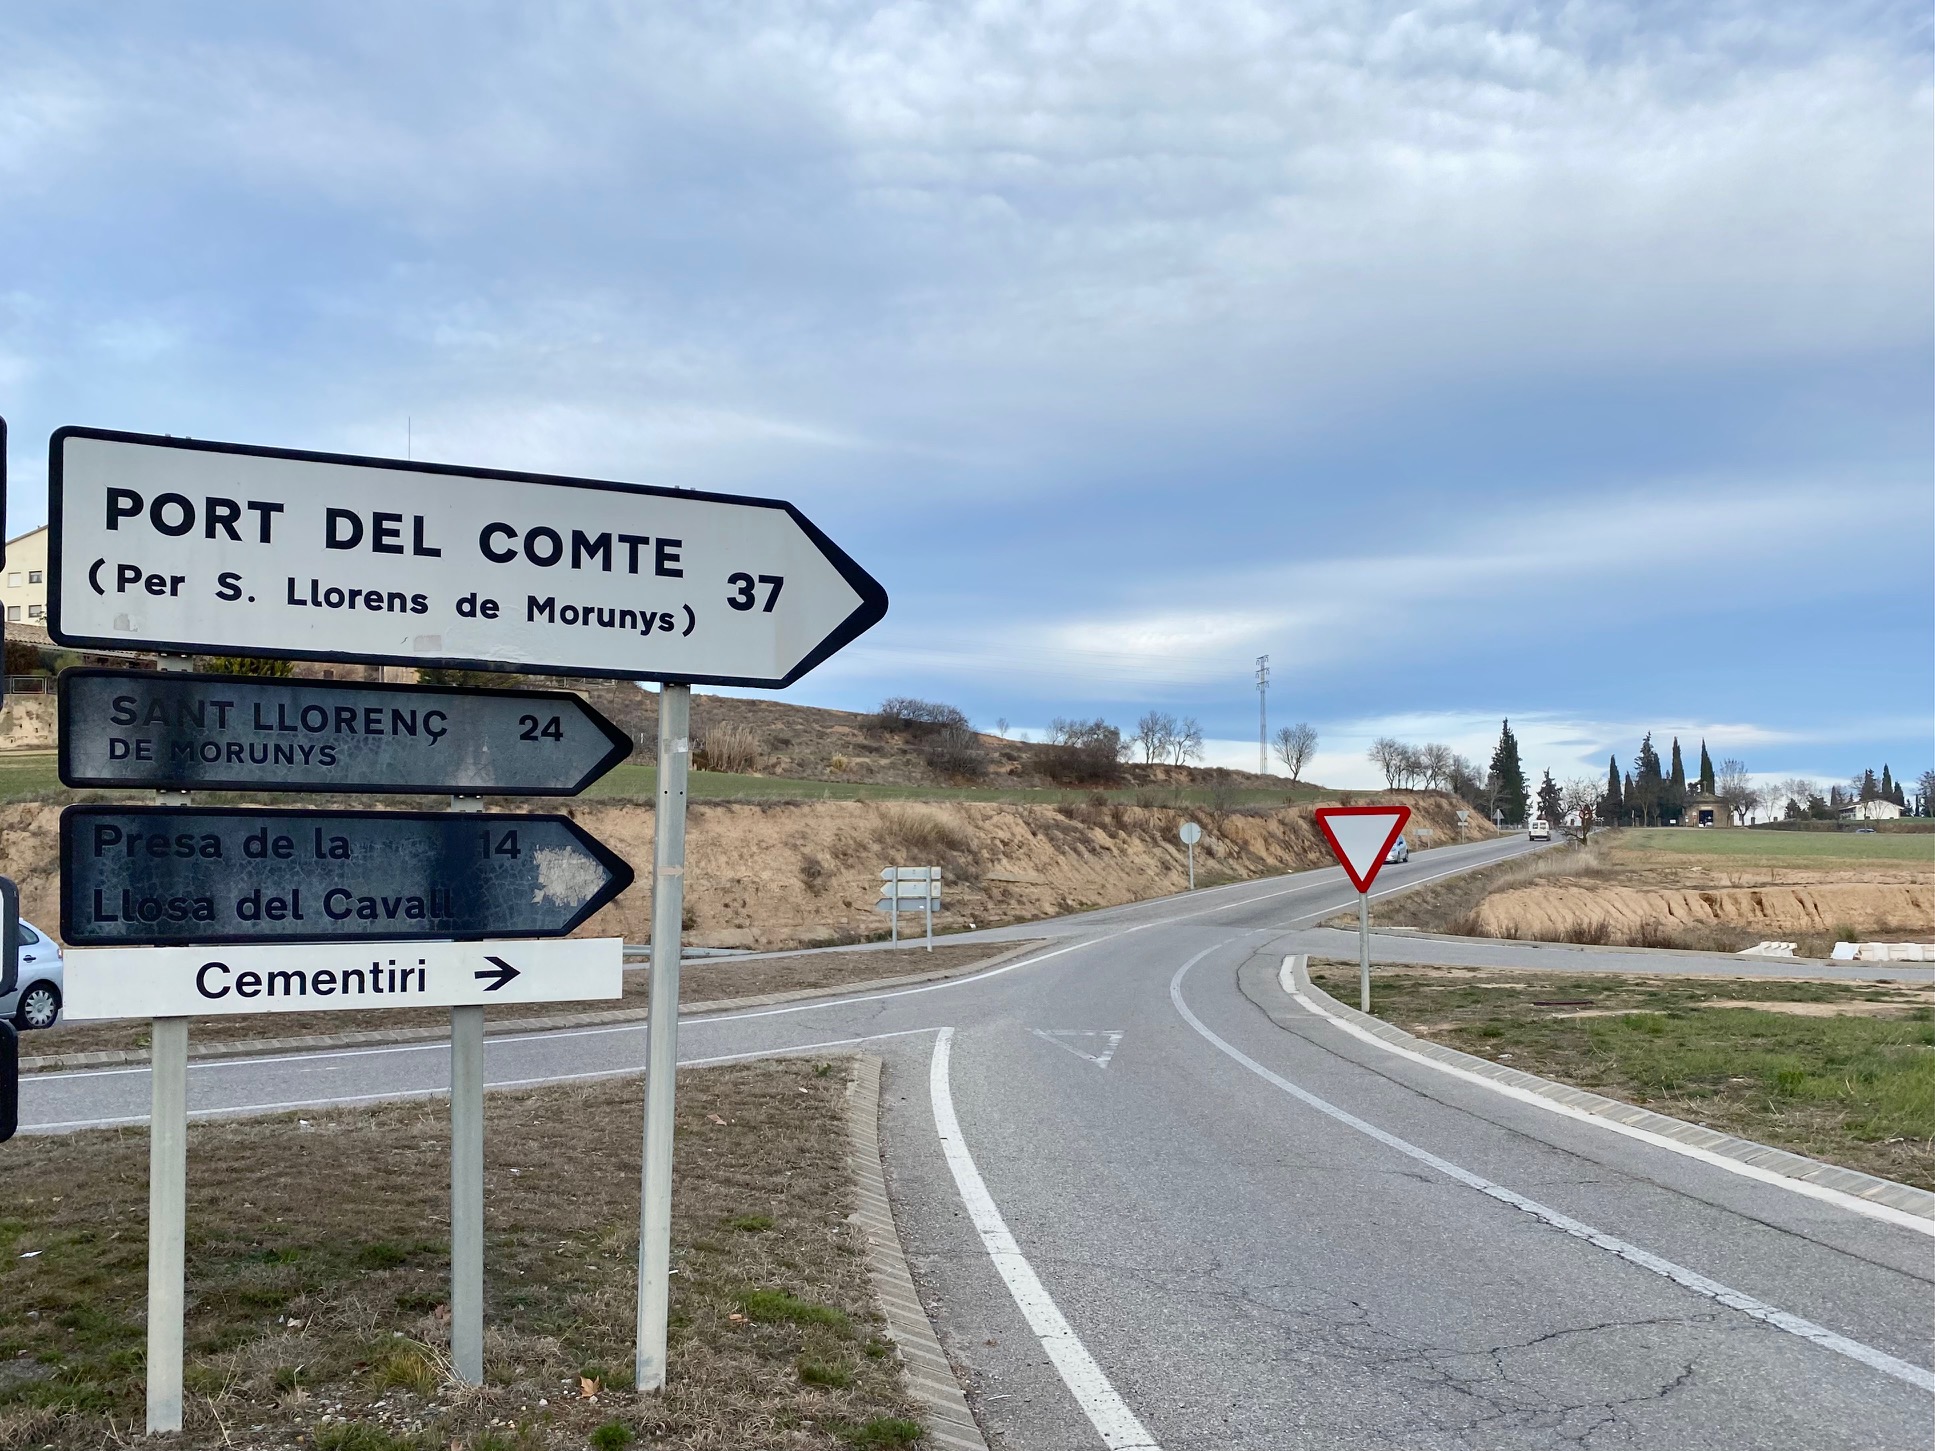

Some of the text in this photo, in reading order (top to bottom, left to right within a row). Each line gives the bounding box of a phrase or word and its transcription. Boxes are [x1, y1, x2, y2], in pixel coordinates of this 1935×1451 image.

[107, 487, 683, 578] PORT DEL COMTE
[89, 558, 695, 637] (Per S. Llorens de Morunys)
[727, 572, 784, 612] 37
[109, 695, 448, 747] SANT LLORENÇ
[518, 714, 563, 742] 24
[109, 737, 337, 766] DE MORUNYS
[94, 824, 351, 859] Presa de la
[480, 830, 521, 859] 14
[94, 887, 454, 923] Llosa del Cavall
[196, 959, 425, 998] Cementiri
